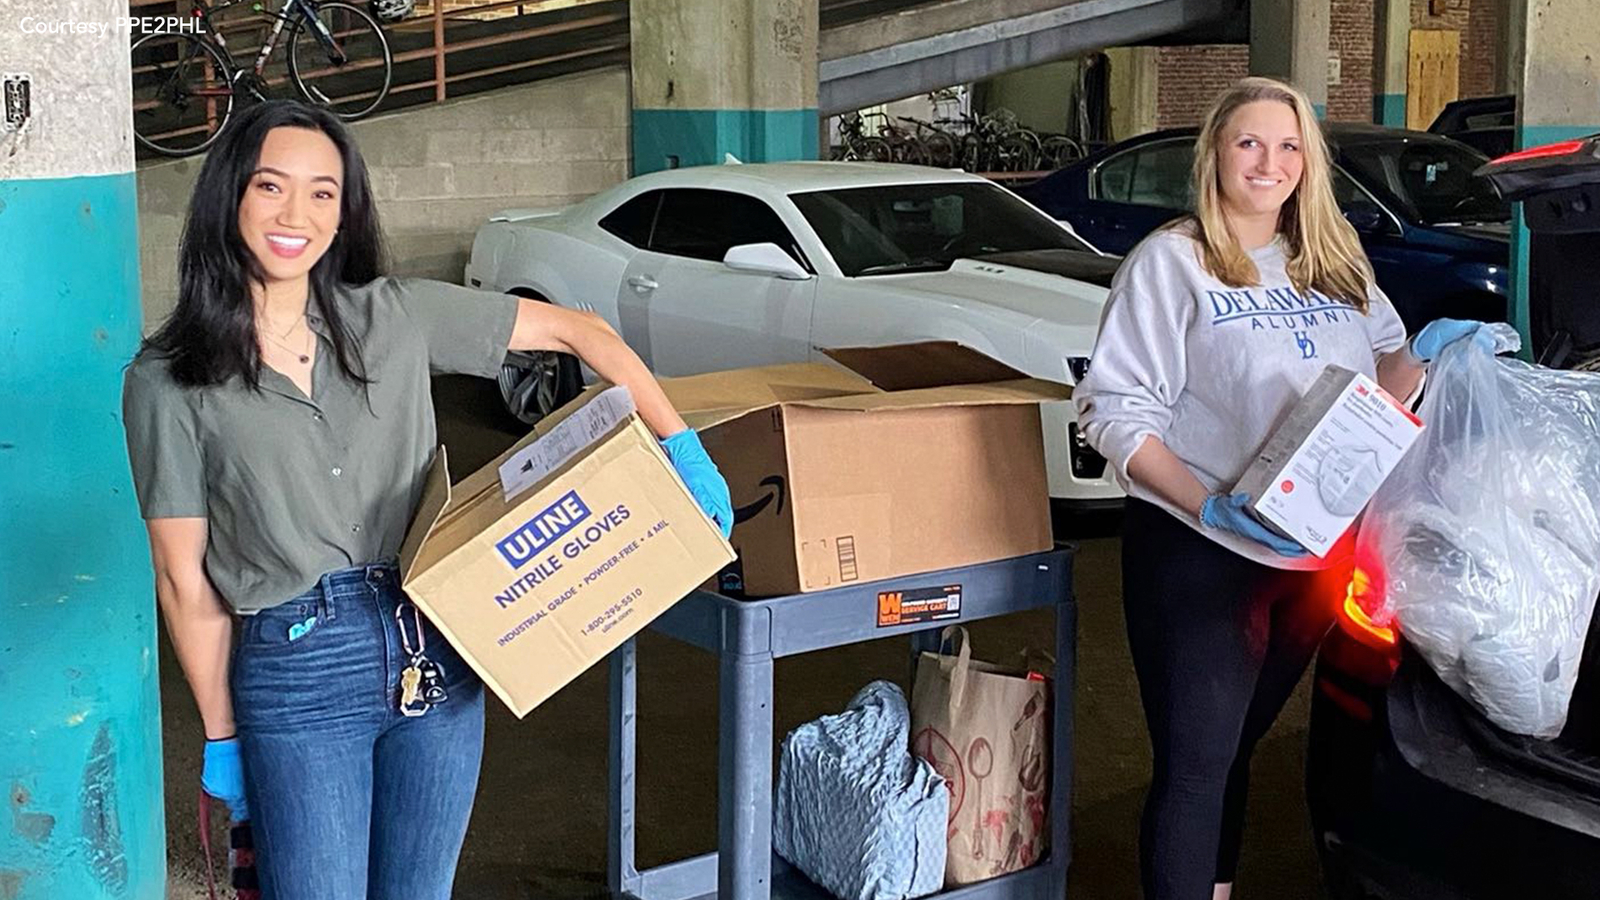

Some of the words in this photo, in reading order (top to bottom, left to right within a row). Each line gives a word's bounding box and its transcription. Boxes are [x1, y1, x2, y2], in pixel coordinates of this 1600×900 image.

[1206, 286, 1350, 318] DELAWA
[1251, 310, 1350, 330] ALUMNI
[504, 496, 584, 560] ULINE
[494, 554, 563, 609] NITRILE
[563, 504, 631, 559] GLOVES
[497, 609, 548, 647] INDUSTRIAL
[547, 586, 578, 611] GRADE
[583, 540, 640, 585] POWDER-FREE
[647, 530, 654, 539] 4
[652, 519, 669, 534] MIL
[581, 588, 643, 637] 1-800-295-5510
